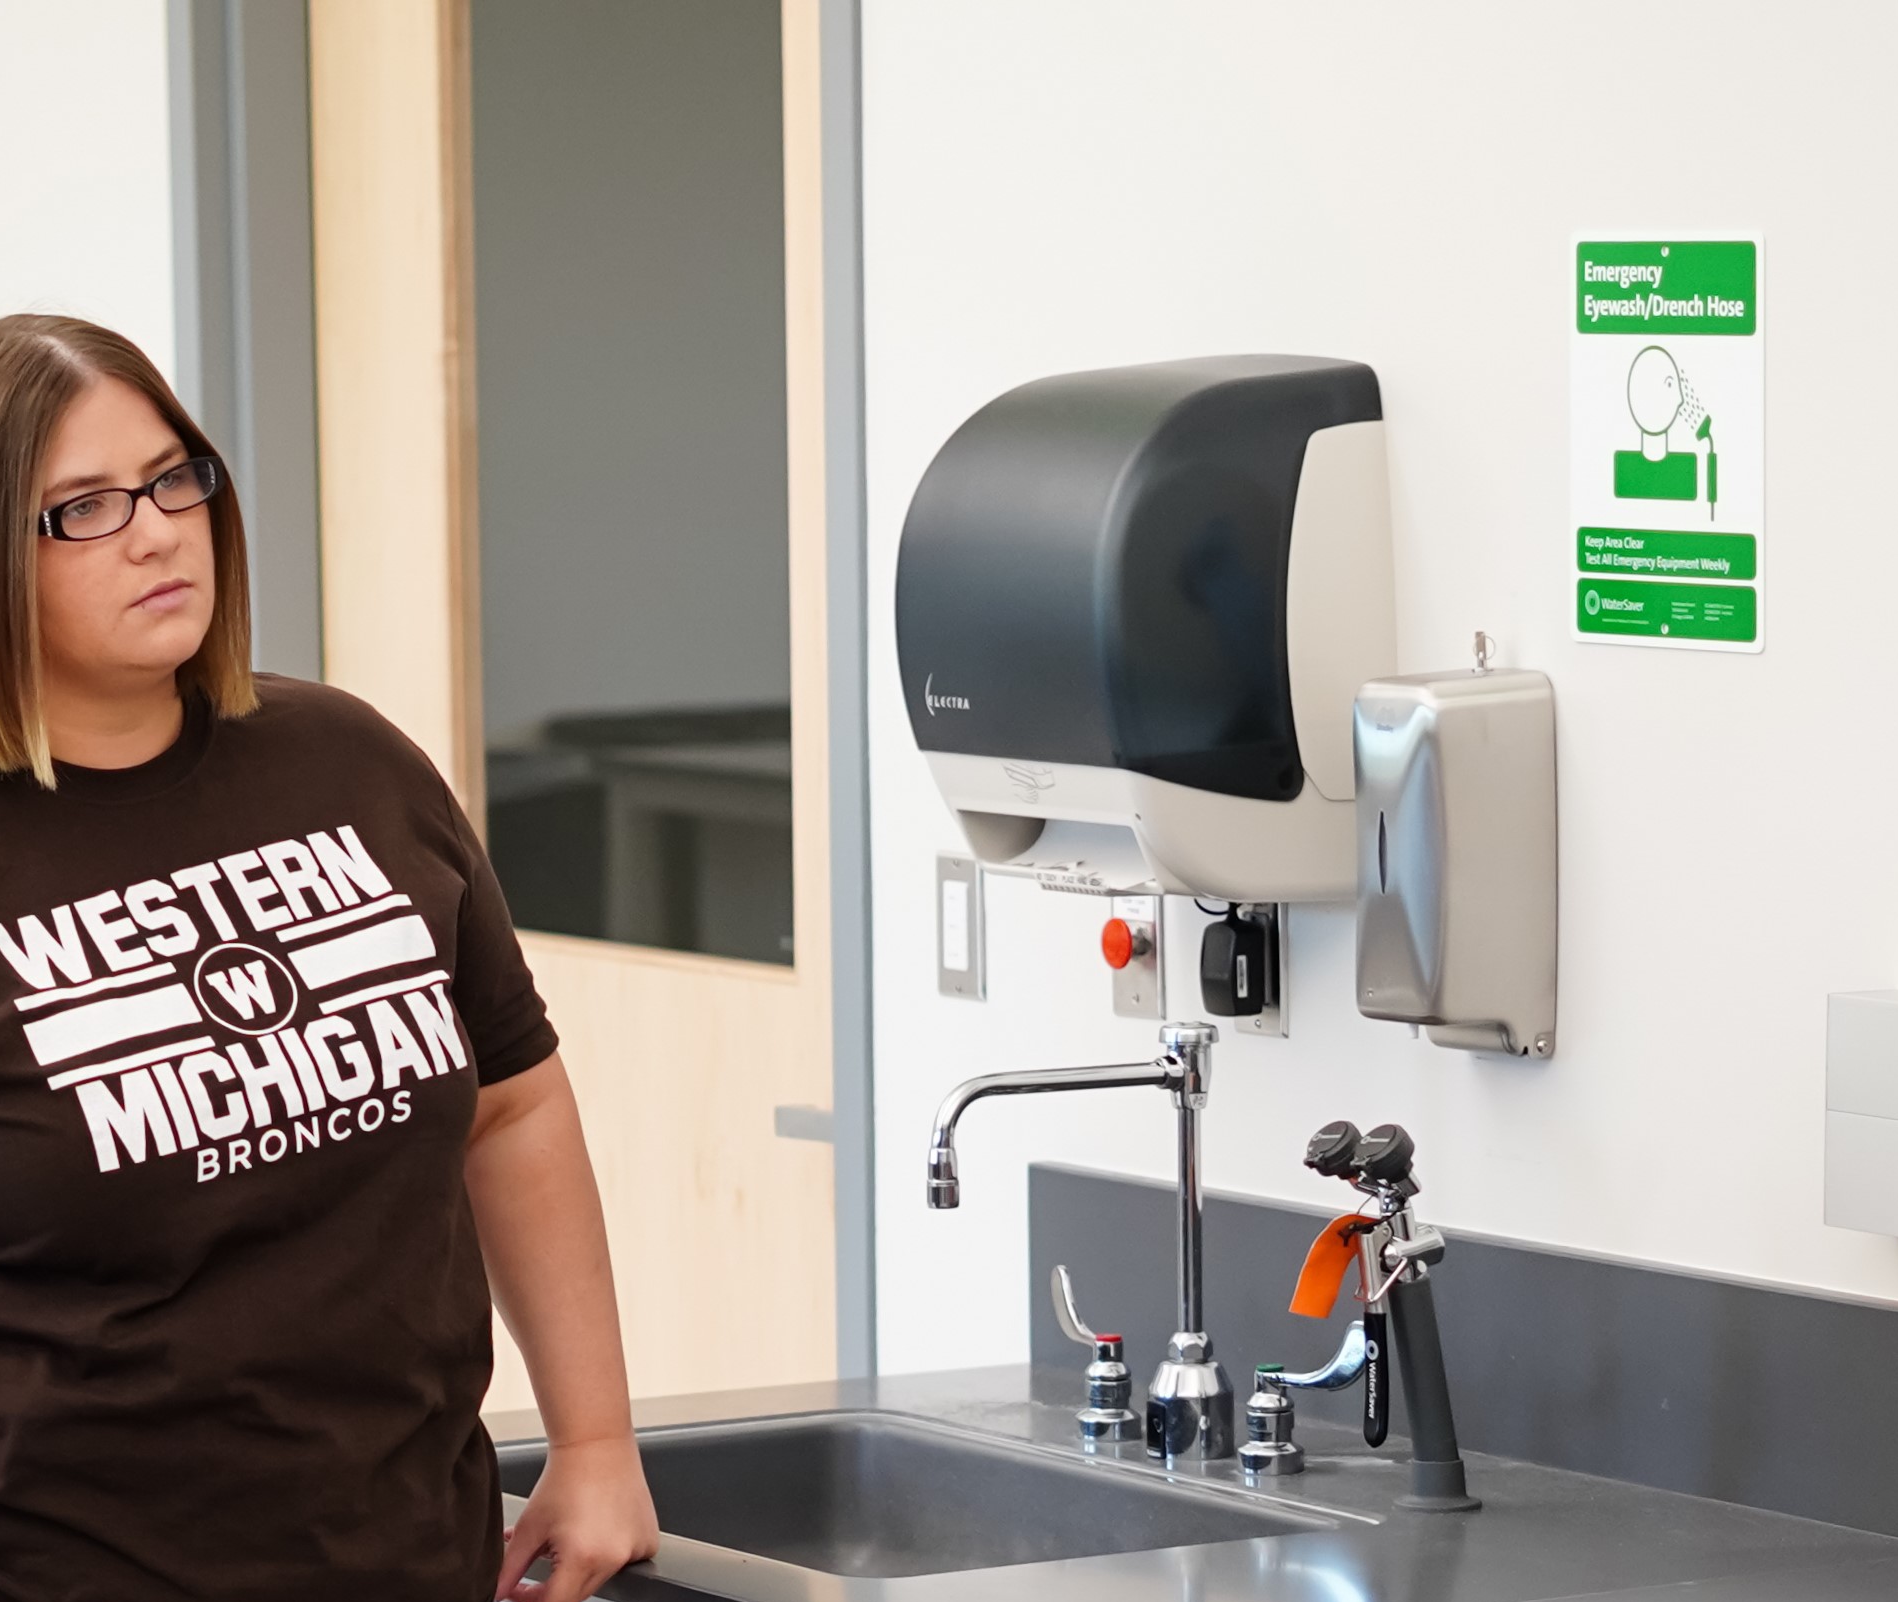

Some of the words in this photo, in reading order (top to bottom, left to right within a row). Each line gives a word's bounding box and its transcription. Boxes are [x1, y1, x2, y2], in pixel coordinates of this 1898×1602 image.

[1584, 261, 1663, 288] Emergency
[1584, 292, 1704, 322] Eyewash/Drench
[1707, 295, 1745, 317] Hose
[1584, 535, 1605, 551] Keep
[1604, 536, 1623, 549] Area
[1624, 536, 1645, 550] Clear
[1584, 552, 1601, 566] Test
[1601, 552, 1613, 566] All
[1613, 553, 1656, 572] Emergency
[1656, 555, 1700, 573] Equipment
[1701, 557, 1731, 575] Weekly
[205, 959, 278, 1020] W
[74, 983, 469, 1173] MICHIGAN
[196, 1089, 413, 1183] BRONCOS
